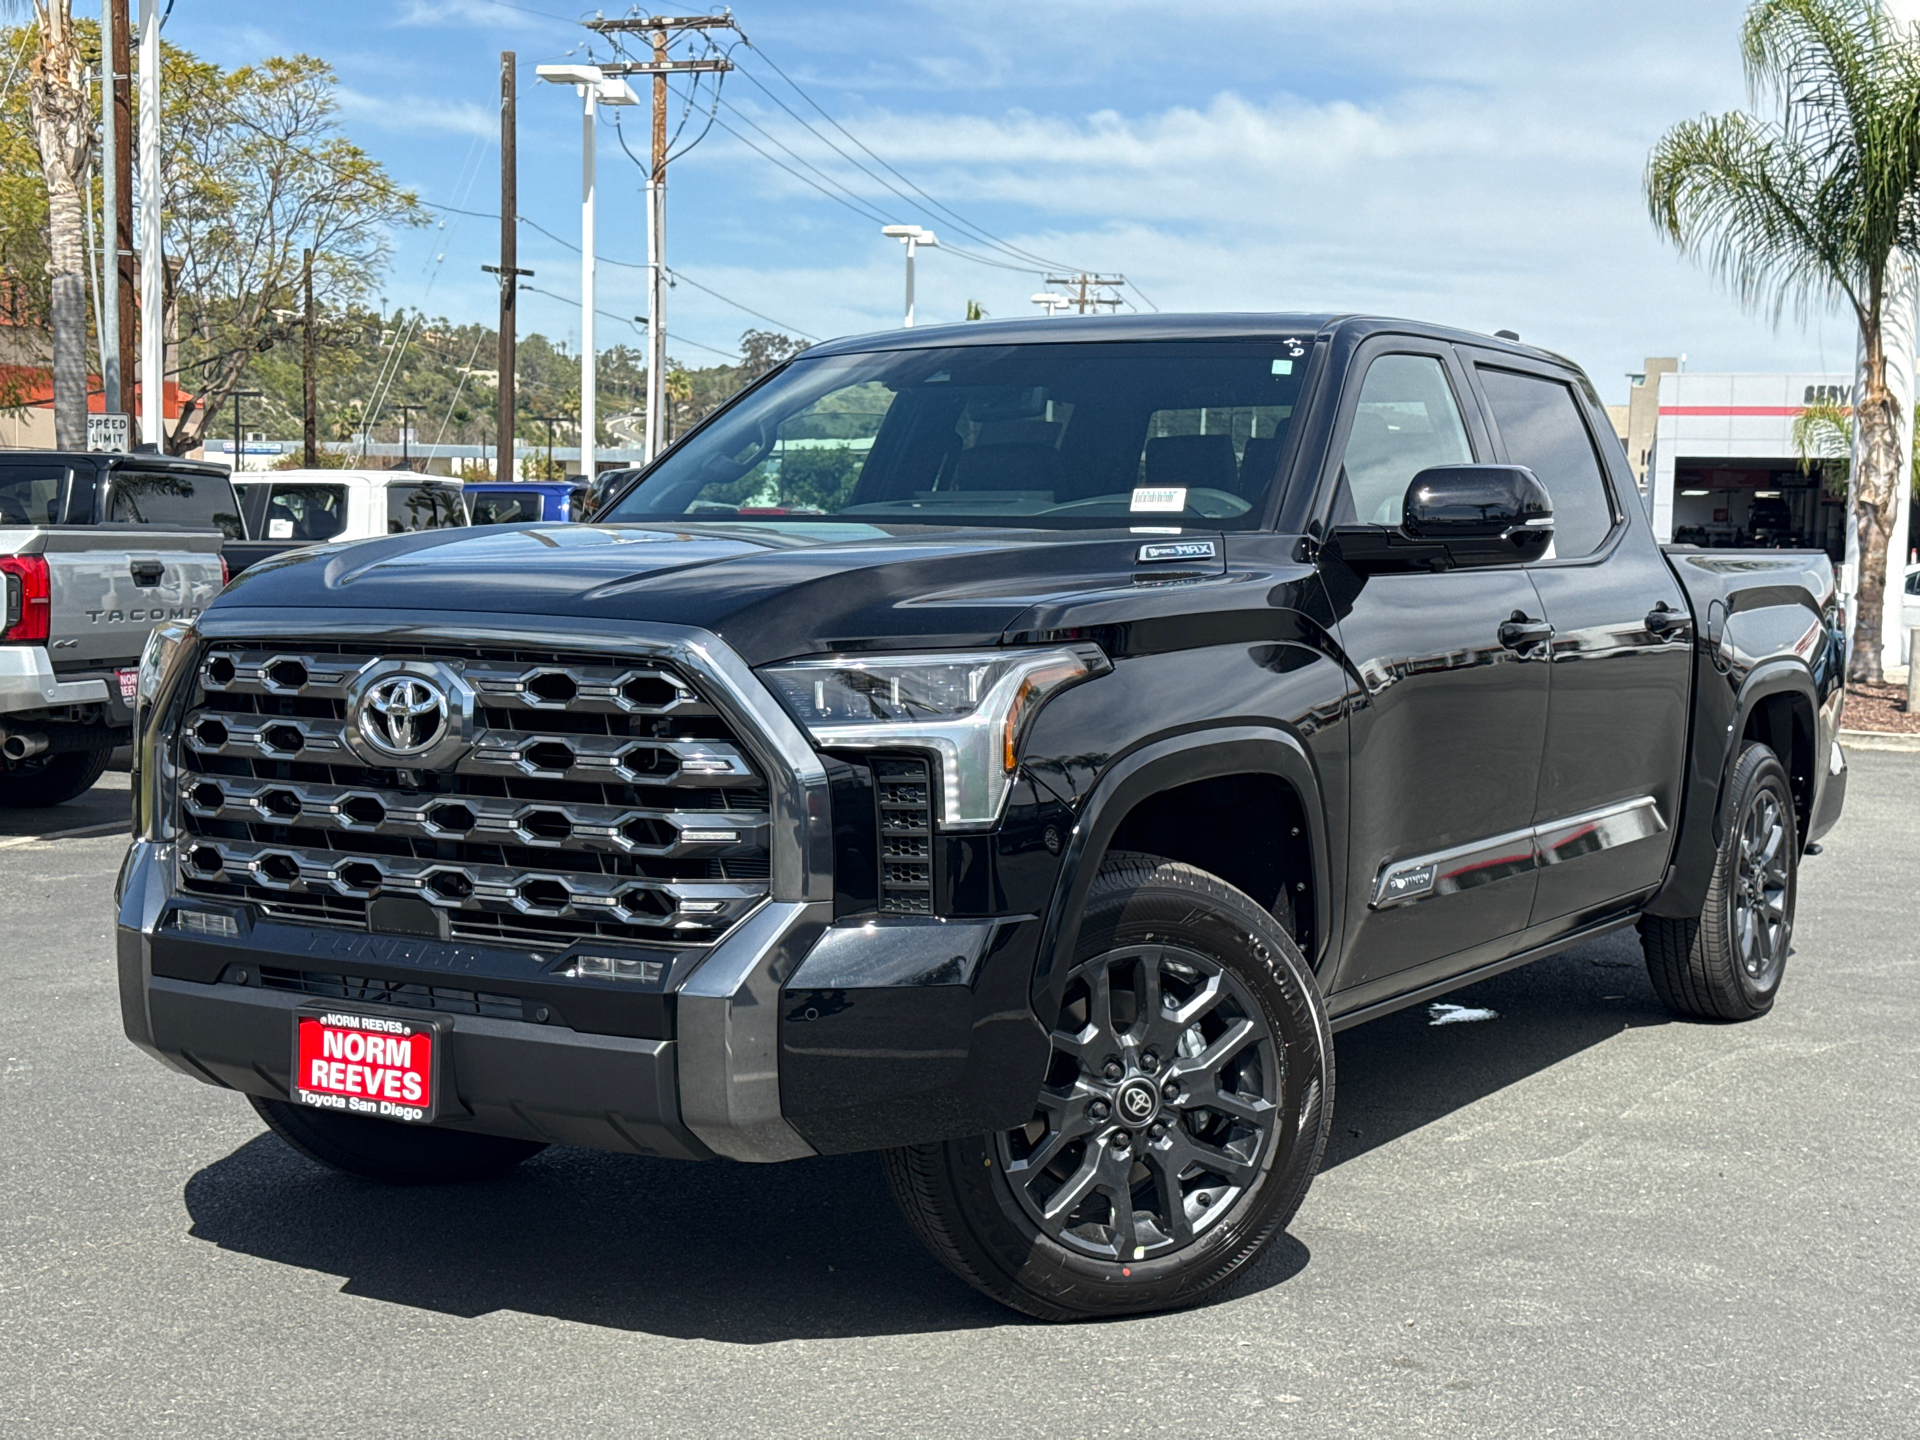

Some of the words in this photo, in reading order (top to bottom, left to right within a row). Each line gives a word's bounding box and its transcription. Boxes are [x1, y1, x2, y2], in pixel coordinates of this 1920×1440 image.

[88, 419, 127, 429] SPEED
[92, 433, 124, 444] LIMIT
[1175, 544, 1211, 556] MAX
[86, 607, 201, 625] TACOMA
[120, 674, 138, 686] NOR
[308, 932, 483, 970] TUNDRA
[327, 1013, 360, 1029] NORM
[361, 1018, 403, 1034] REEVES
[323, 1030, 411, 1068] NORM
[311, 1059, 422, 1100] REEVES
[299, 1090, 346, 1108] Toyota
[349, 1097, 377, 1112] San
[380, 1103, 423, 1121] Diego
